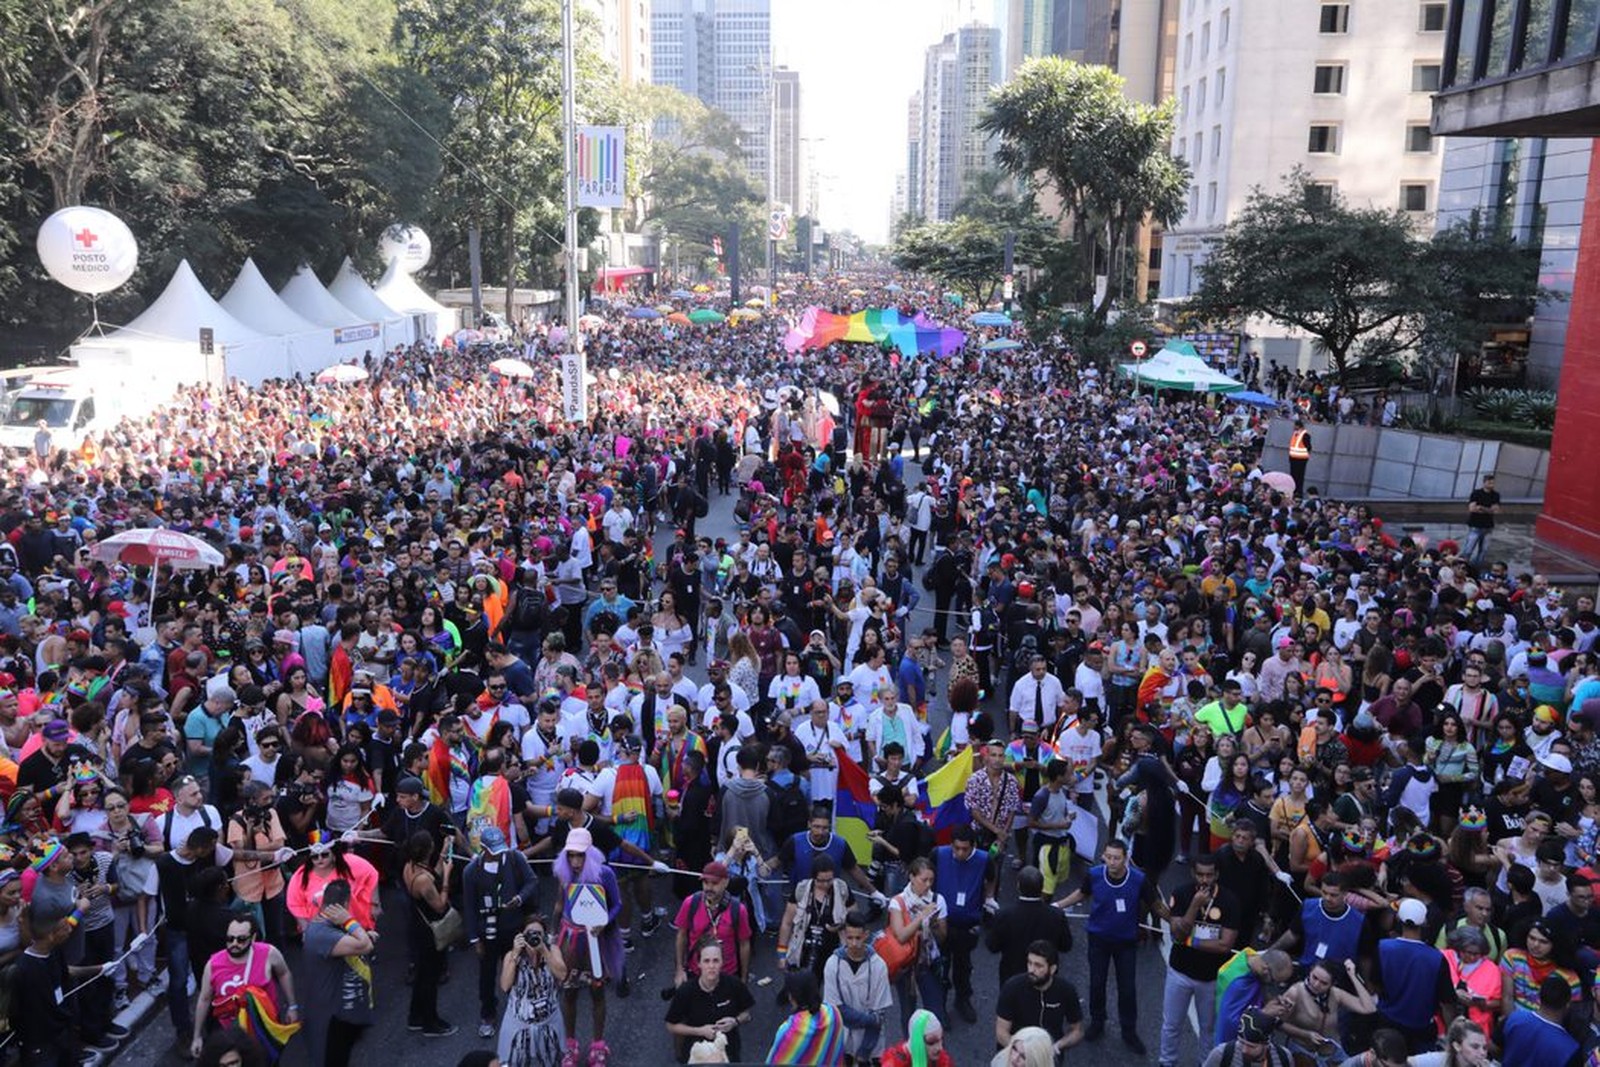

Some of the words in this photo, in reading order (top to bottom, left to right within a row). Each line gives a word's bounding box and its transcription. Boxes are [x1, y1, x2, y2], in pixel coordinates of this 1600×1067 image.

[578, 178, 618, 198] PARADA
[72, 253, 107, 263] POSTO
[156, 547, 189, 559] AMSTEL
